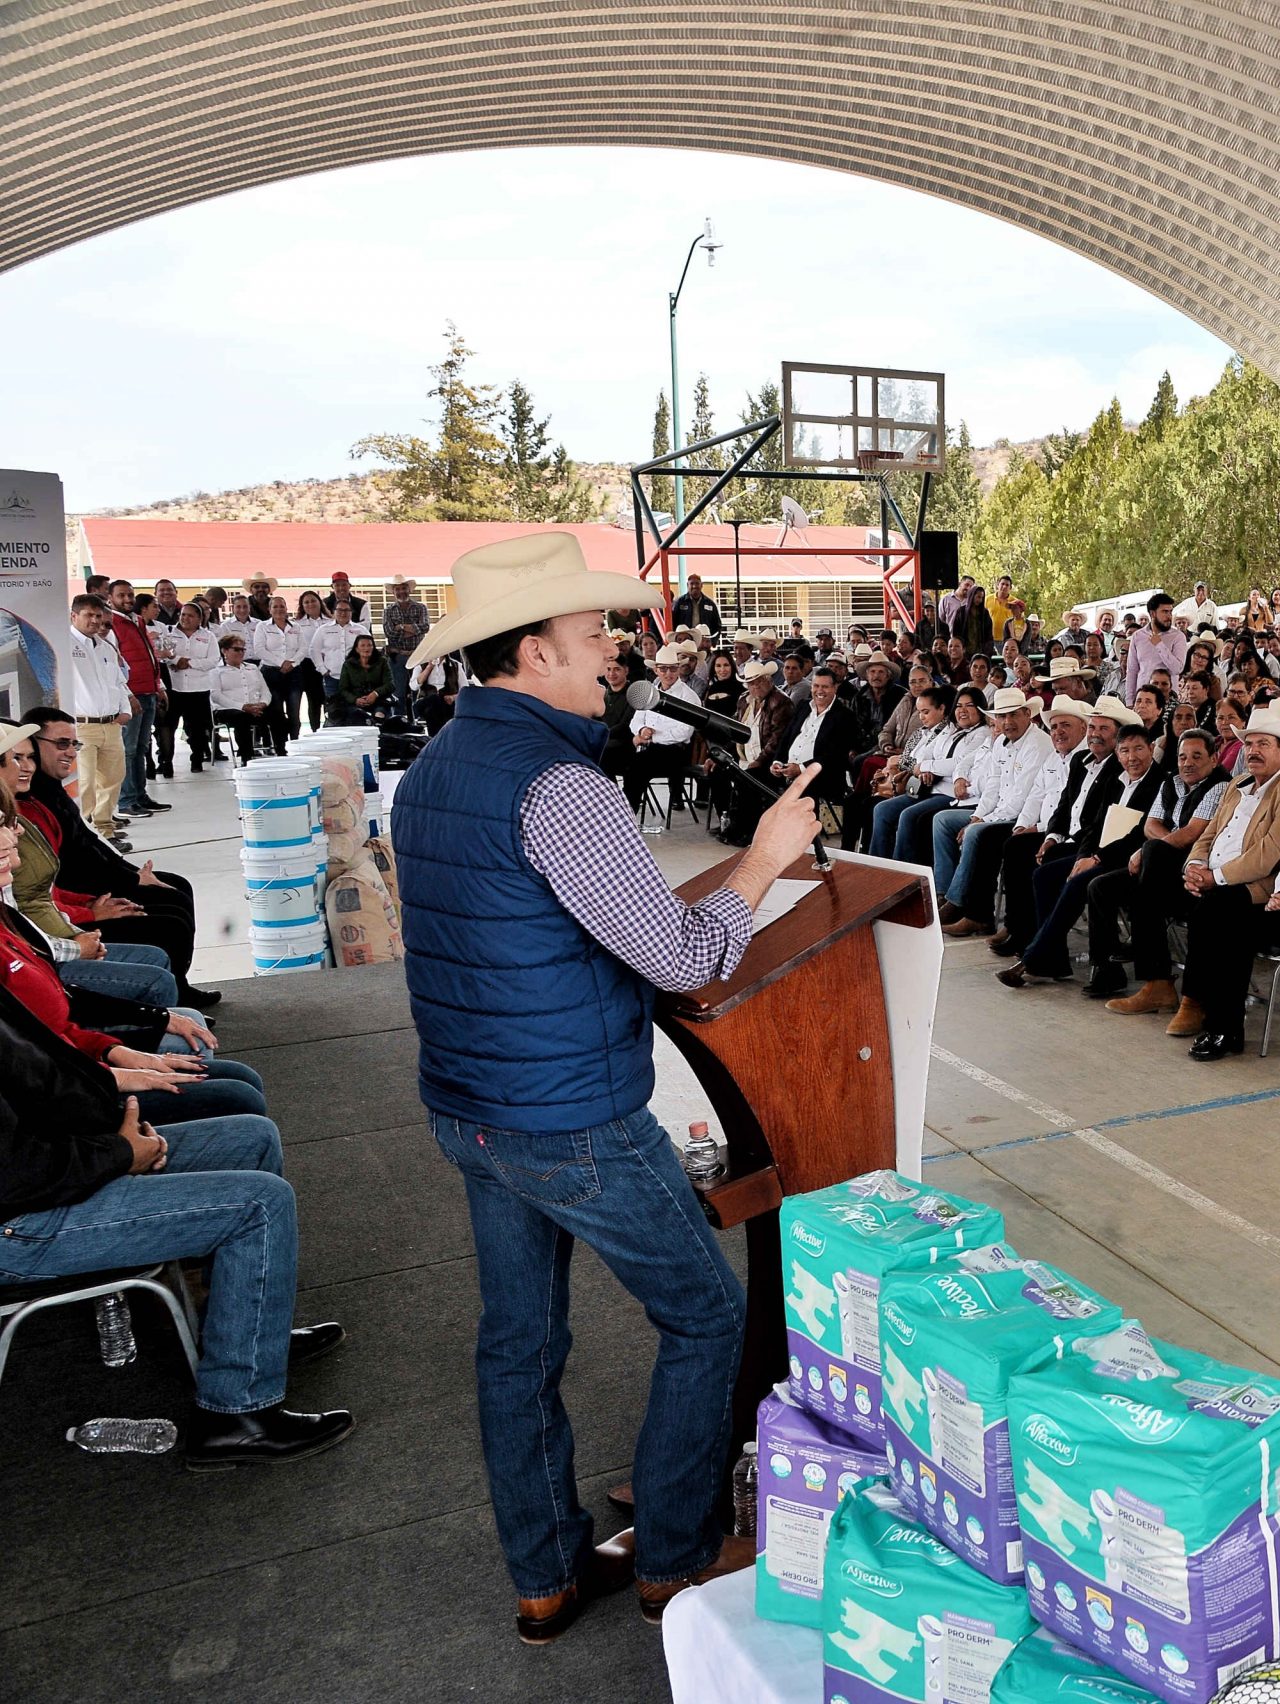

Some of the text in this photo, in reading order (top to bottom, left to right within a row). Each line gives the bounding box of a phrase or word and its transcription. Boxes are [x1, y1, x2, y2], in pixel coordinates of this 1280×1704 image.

[33, 579, 52, 588] BAÑO
[792, 1224, 823, 1249] Affective
[1241, 1394, 1257, 1408] 10
[1025, 1421, 1073, 1458] Affective
[1118, 1508, 1160, 1536] PRO DERM
[781, 1571, 818, 1586] DERM PRO
[846, 1564, 897, 1590] Affective
[947, 1628, 990, 1647] PRO DERM
